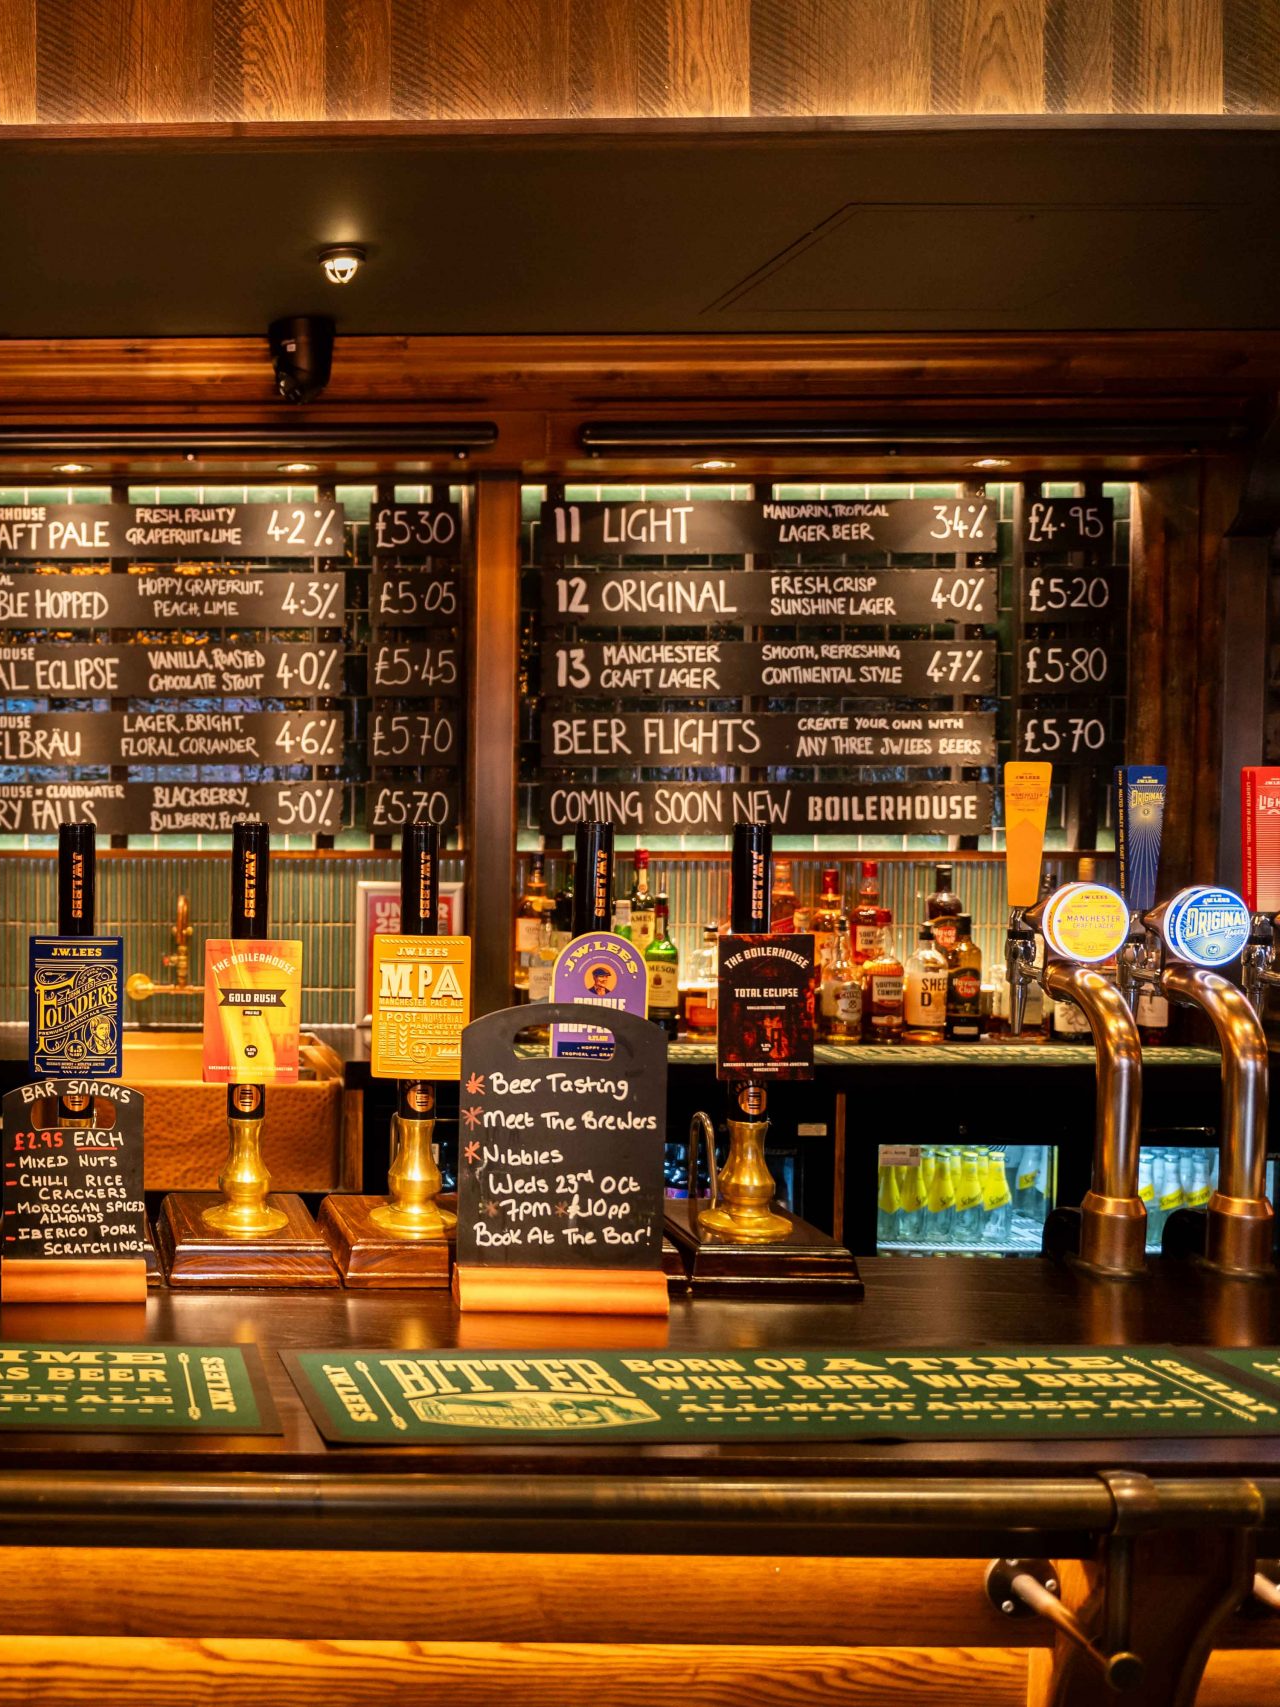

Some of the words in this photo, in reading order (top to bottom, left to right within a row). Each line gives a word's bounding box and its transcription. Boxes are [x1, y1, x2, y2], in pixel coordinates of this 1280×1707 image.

[184, 508, 236, 524] FRUITY
[834, 504, 889, 518] TROPICAL
[48, 521, 110, 548] PALE
[555, 508, 581, 543] 11
[603, 507, 694, 543] LIGHT
[779, 524, 829, 542] LAGER
[831, 523, 875, 542] BEER
[832, 576, 877, 592] CRISP
[35, 589, 108, 620] HOPPED
[555, 578, 589, 614] 12
[602, 579, 737, 614] ORIGINAL
[204, 601, 239, 616] LIME
[770, 597, 846, 616] SUNSHINE
[850, 598, 896, 616] LAGER
[214, 649, 266, 670] ROASTED
[603, 645, 721, 665] MANCHESTER
[821, 645, 900, 660] REFRESHING
[35, 658, 118, 690] ECLIPSE
[556, 649, 591, 688] 13
[762, 666, 855, 685] CONTINENTAL
[860, 665, 902, 684] STYLE
[149, 672, 217, 691] CHOCOLATE
[222, 672, 264, 691] STOUT
[600, 669, 653, 689] CRAFT
[659, 669, 720, 690] LAGER
[798, 718, 849, 731] CREATE
[855, 718, 888, 731] YOUR
[892, 718, 923, 730] OWN
[928, 718, 964, 730] WITH
[179, 737, 258, 757] CORIANDER
[553, 720, 632, 755] BEER
[644, 719, 761, 756] FLIGHTS
[796, 738, 827, 757] ANY
[831, 737, 874, 755] THREE
[939, 738, 981, 756] BEERS
[46, 785, 124, 799] CLOUDWATER
[654, 790, 721, 824] SOON
[734, 792, 790, 824] NEW
[808, 796, 977, 822] BOILERHOUSE
[1187, 908, 1247, 937] ORIGINAL
[212, 958, 230, 974] THE
[232, 953, 296, 975] BOILERHOUSE
[724, 954, 744, 969] THE
[744, 947, 810, 969] BOILERHOUSE
[380, 963, 464, 999] MPA
[229, 993, 251, 1002] GOLD
[254, 994, 276, 1003] RUSH
[734, 988, 761, 998] TOTAL
[763, 988, 798, 997] ECLIPSE
[22, 1082, 57, 1103] BAR
[67, 1081, 131, 1103] SNACKS
[489, 1072, 541, 1095] Beer
[546, 1073, 628, 1100] Tasting
[581, 1111, 657, 1129] Brewers
[14, 1132, 63, 1150] £2.95
[74, 1132, 123, 1148] EACH
[20, 1156, 68, 1168] MIXED
[79, 1155, 117, 1167] NUTS
[483, 1144, 563, 1166] Nibbles
[20, 1174, 68, 1187] CHILLI
[86, 1175, 123, 1186] RICE
[39, 1188, 126, 1200] CRACKERS
[17, 1202, 99, 1214] MOROCCAN
[106, 1201, 145, 1212] SPICED
[40, 1213, 103, 1224] ALMONDS
[18, 1228, 88, 1239] IBERICO
[101, 1224, 136, 1237] PORK
[473, 1222, 522, 1246] Book
[44, 1242, 144, 1256] SCRATCHINGS
[46, 1367, 168, 1383] BEER
[380, 1359, 636, 1398] BITTER
